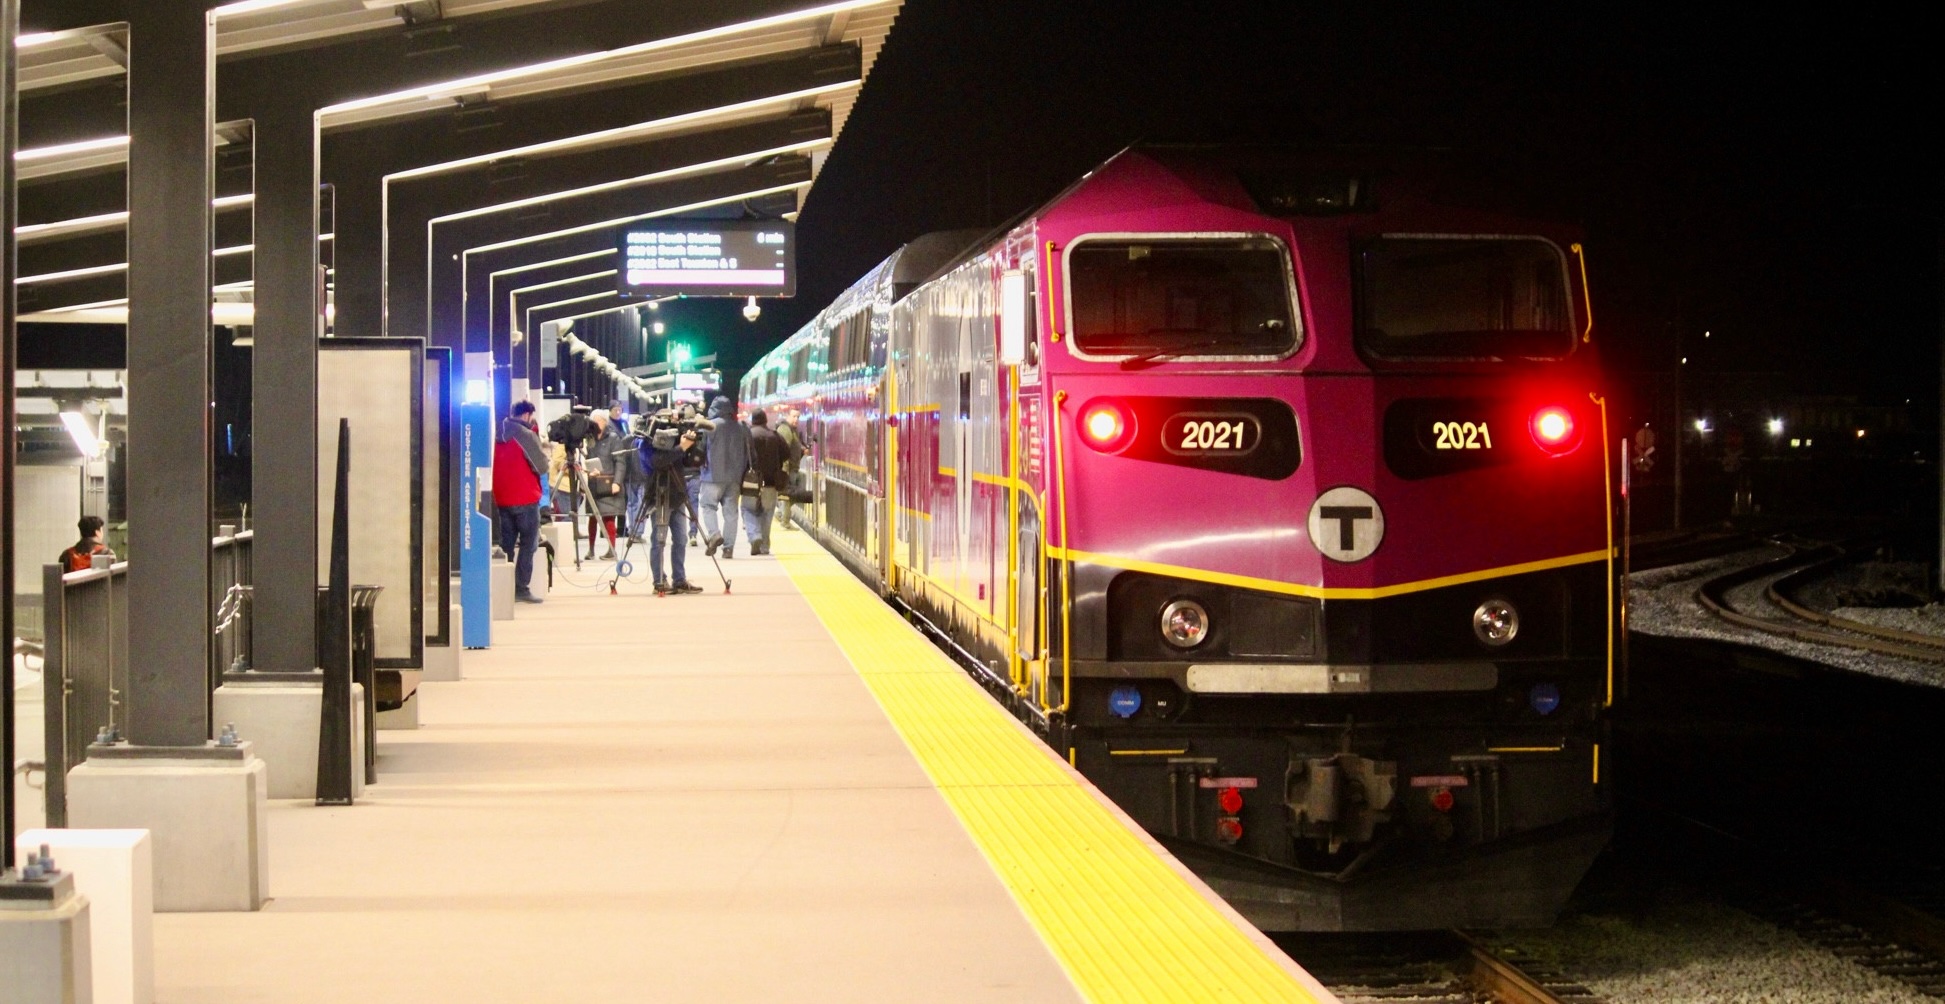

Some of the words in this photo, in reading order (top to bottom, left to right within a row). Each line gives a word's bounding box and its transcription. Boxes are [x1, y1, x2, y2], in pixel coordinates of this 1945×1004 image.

[1181, 421, 1244, 449] 2021
[1433, 421, 1492, 449] 2021
[1320, 506, 1373, 550] T
